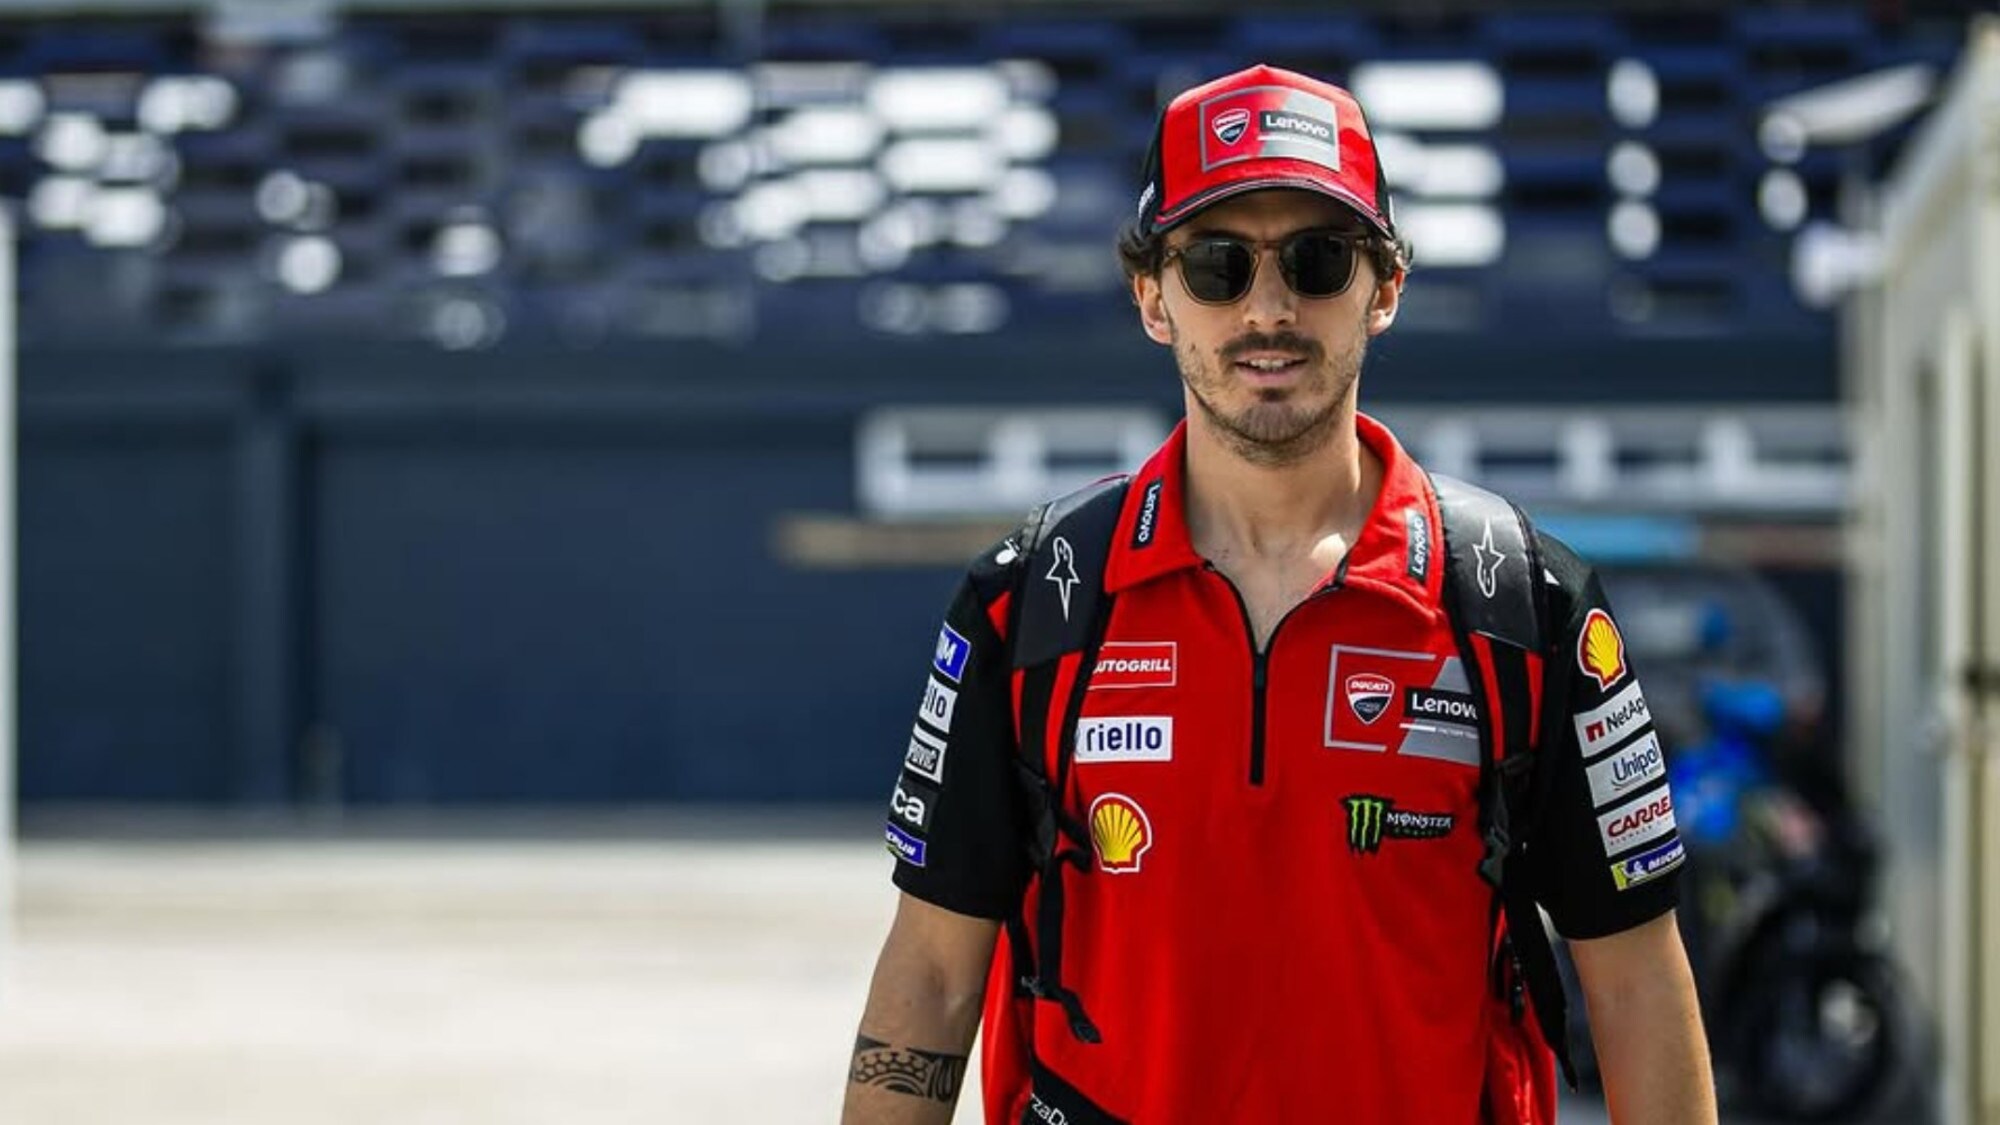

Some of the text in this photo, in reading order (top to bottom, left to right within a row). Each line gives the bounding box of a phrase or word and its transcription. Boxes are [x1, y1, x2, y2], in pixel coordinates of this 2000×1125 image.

[1265, 114, 1331, 138] Lenovo
[1137, 483, 1161, 543] Lenovo
[1411, 516, 1425, 575] Lenovo
[1086, 722, 1163, 752] riello
[1612, 738, 1660, 781] Unipol
[1386, 811, 1452, 829] MONSTER
